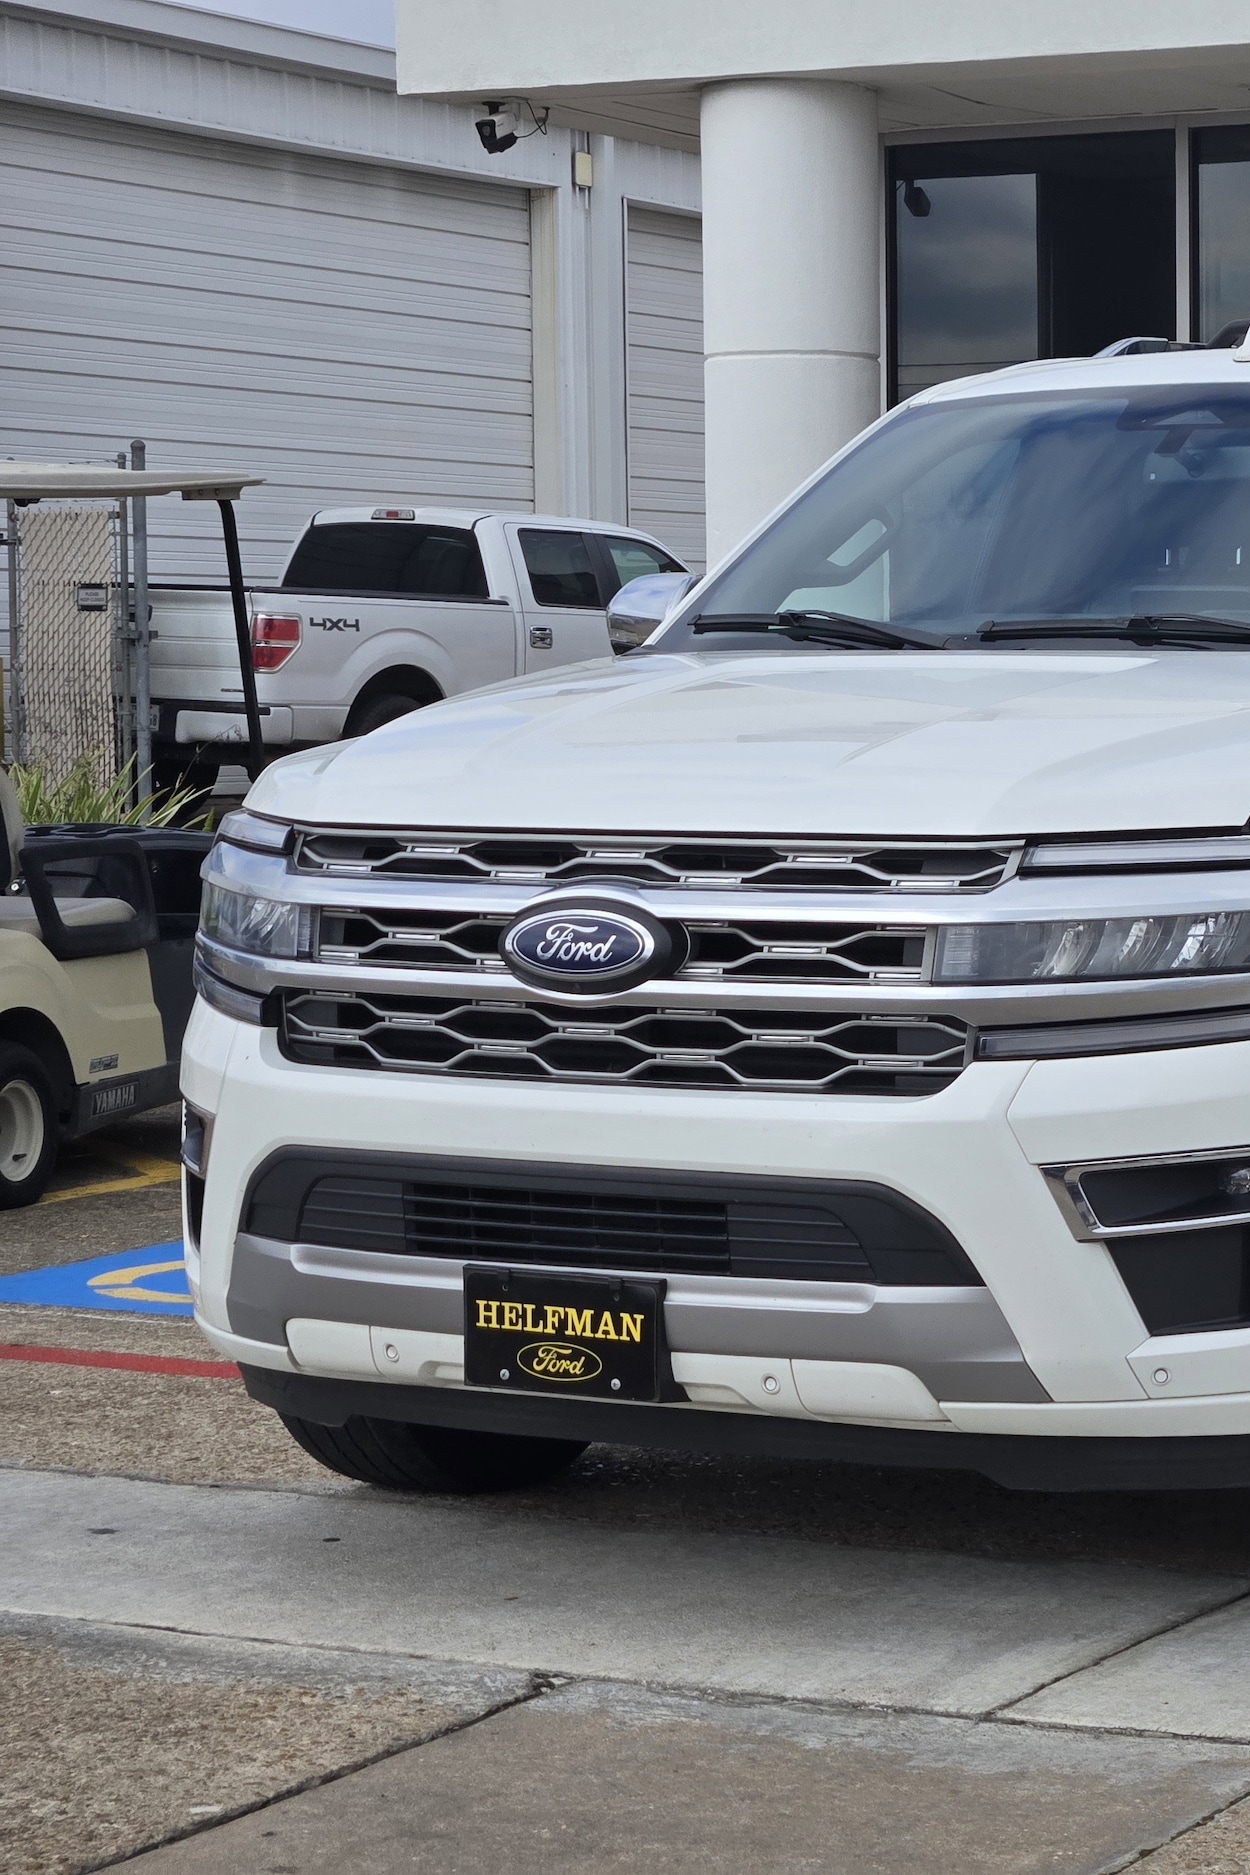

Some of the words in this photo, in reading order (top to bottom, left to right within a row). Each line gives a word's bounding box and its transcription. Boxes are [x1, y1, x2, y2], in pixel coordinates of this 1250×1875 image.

[536, 922, 617, 963] Ford
[95, 1085, 135, 1113] YAMAHA
[475, 1299, 645, 1343] HELFMAN
[532, 1345, 586, 1375] Ford
